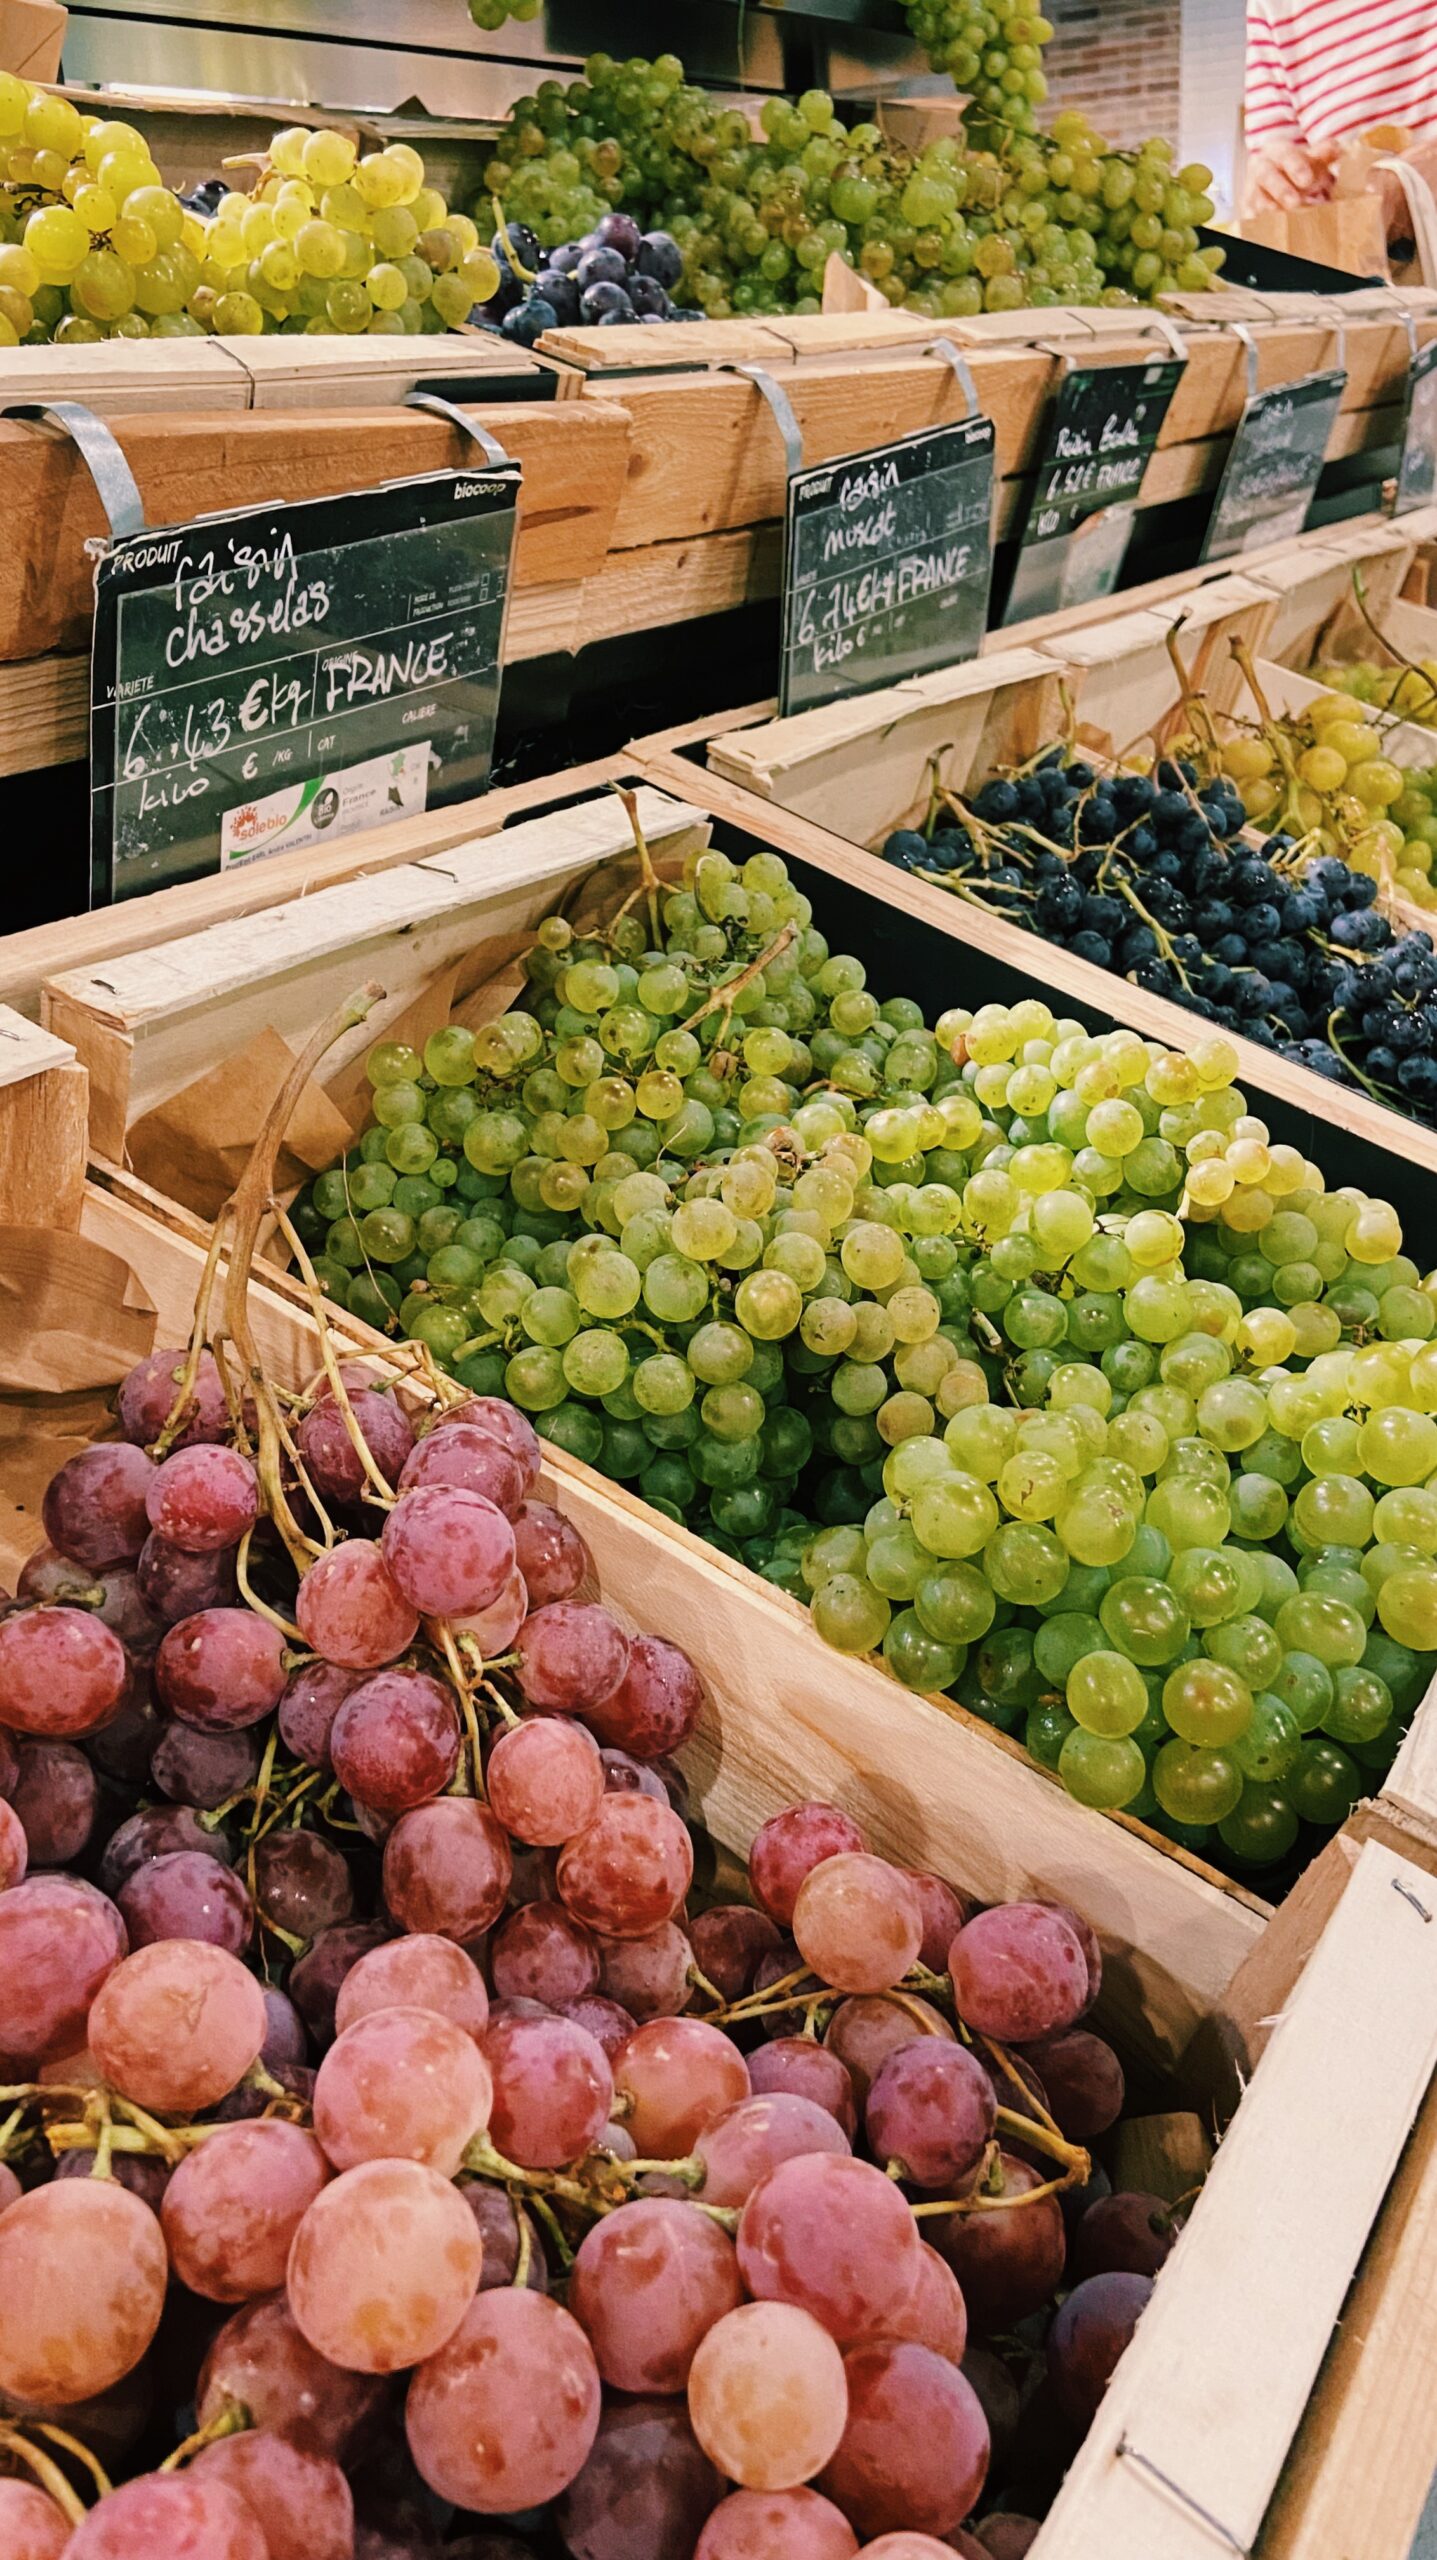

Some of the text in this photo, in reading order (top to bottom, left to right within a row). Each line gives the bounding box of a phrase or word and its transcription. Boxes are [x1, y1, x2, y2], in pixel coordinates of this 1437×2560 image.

[454, 483, 506, 500] biocoop
[111, 540, 183, 575] PRODUIT
[898, 546, 972, 602] FRANCE
[326, 632, 454, 712] FRANCE
[402, 703, 438, 724] CALIBRE
[241, 752, 259, 780] €
